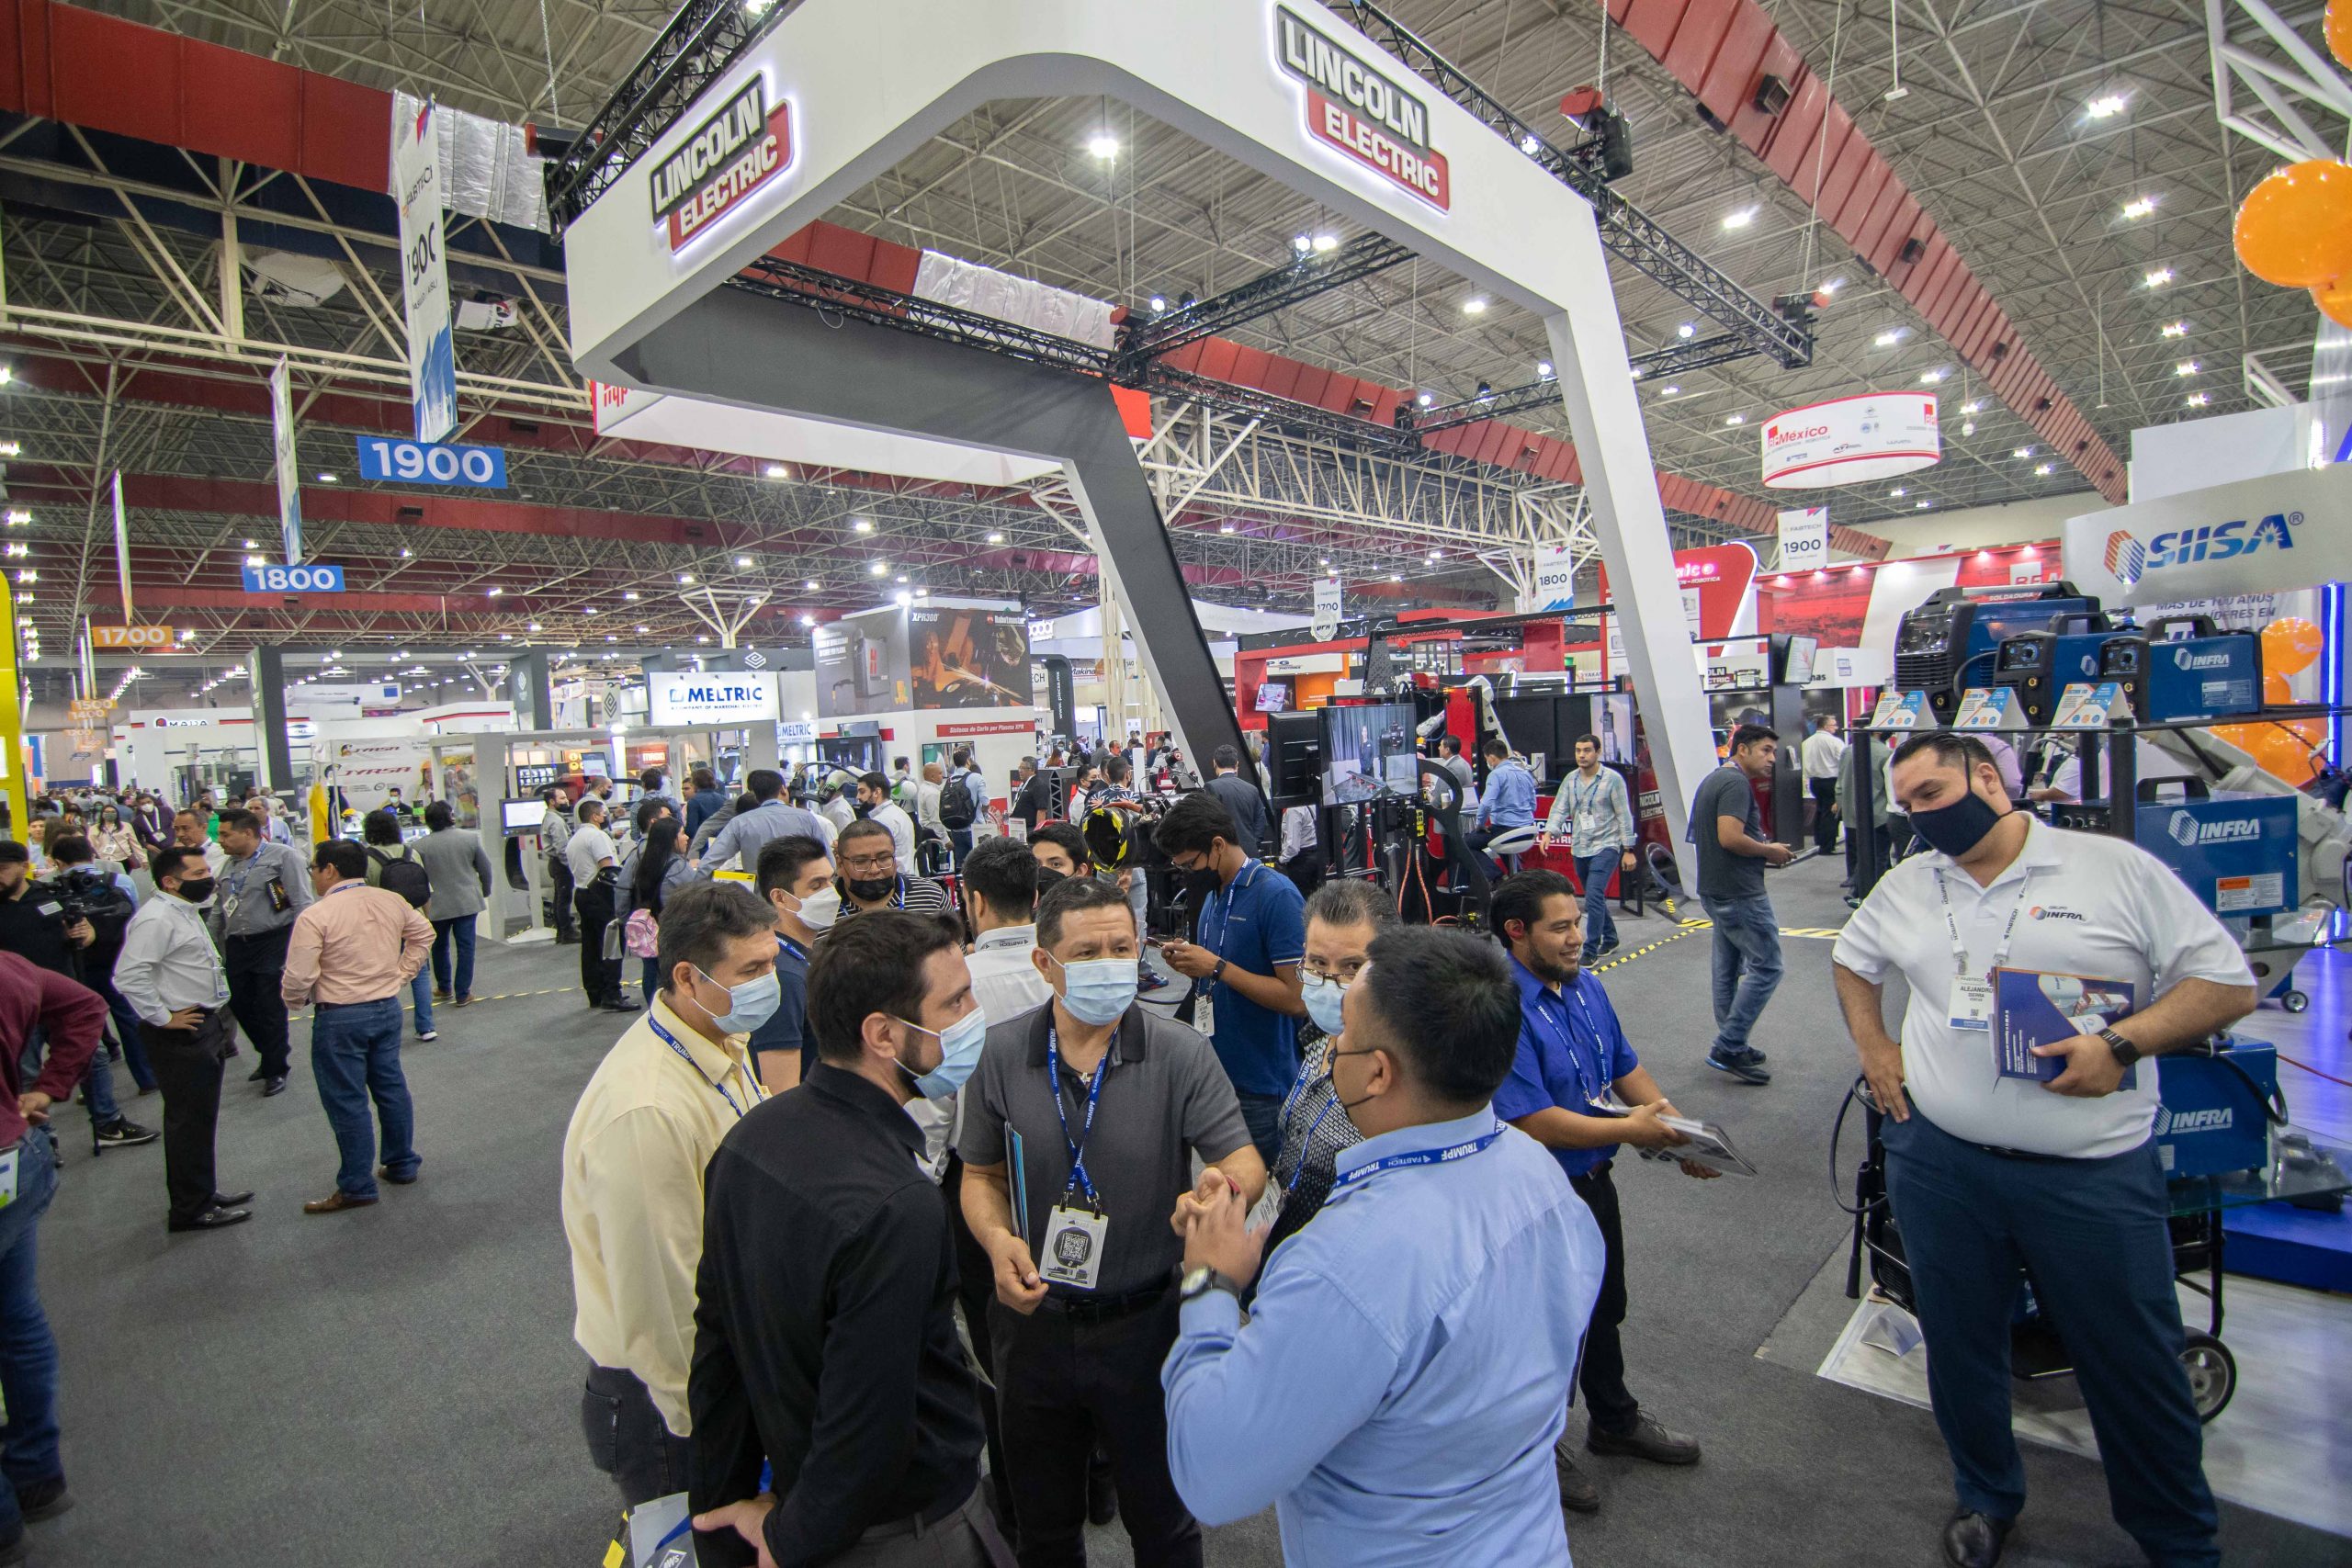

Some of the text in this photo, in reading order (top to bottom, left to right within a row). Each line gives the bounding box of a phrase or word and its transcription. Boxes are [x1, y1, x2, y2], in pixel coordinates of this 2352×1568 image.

[1284, 17, 1423, 147] LINCOLN
[653, 86, 761, 213] LINCOLN
[1324, 102, 1439, 197] ELECTRIC
[680, 135, 778, 237] ELECTRIC
[371, 442, 495, 484] 1900
[1783, 538, 1822, 554] 1900
[252, 566, 336, 591] 1800
[1539, 573, 1567, 586] 1800
[1317, 602, 1339, 611] 1700
[100, 627, 165, 645] 1700
[2192, 654, 2230, 666] INFRA
[75, 700, 113, 710] 1500
[688, 687, 763, 702] MELTRIC
[782, 724, 811, 737] MELTRIC
[2199, 818, 2260, 839] INFRA
[2006, 908, 2018, 934] FABTECH
[2046, 911, 2083, 920] INFRA
[1093, 1066, 1102, 1089] FABTECH
[1085, 1100, 1096, 1129] TRUMPF
[2171, 1108, 2233, 1129] INFRA
[1347, 1142, 1477, 1182] TRUMPF FABTECH TRUMPF
